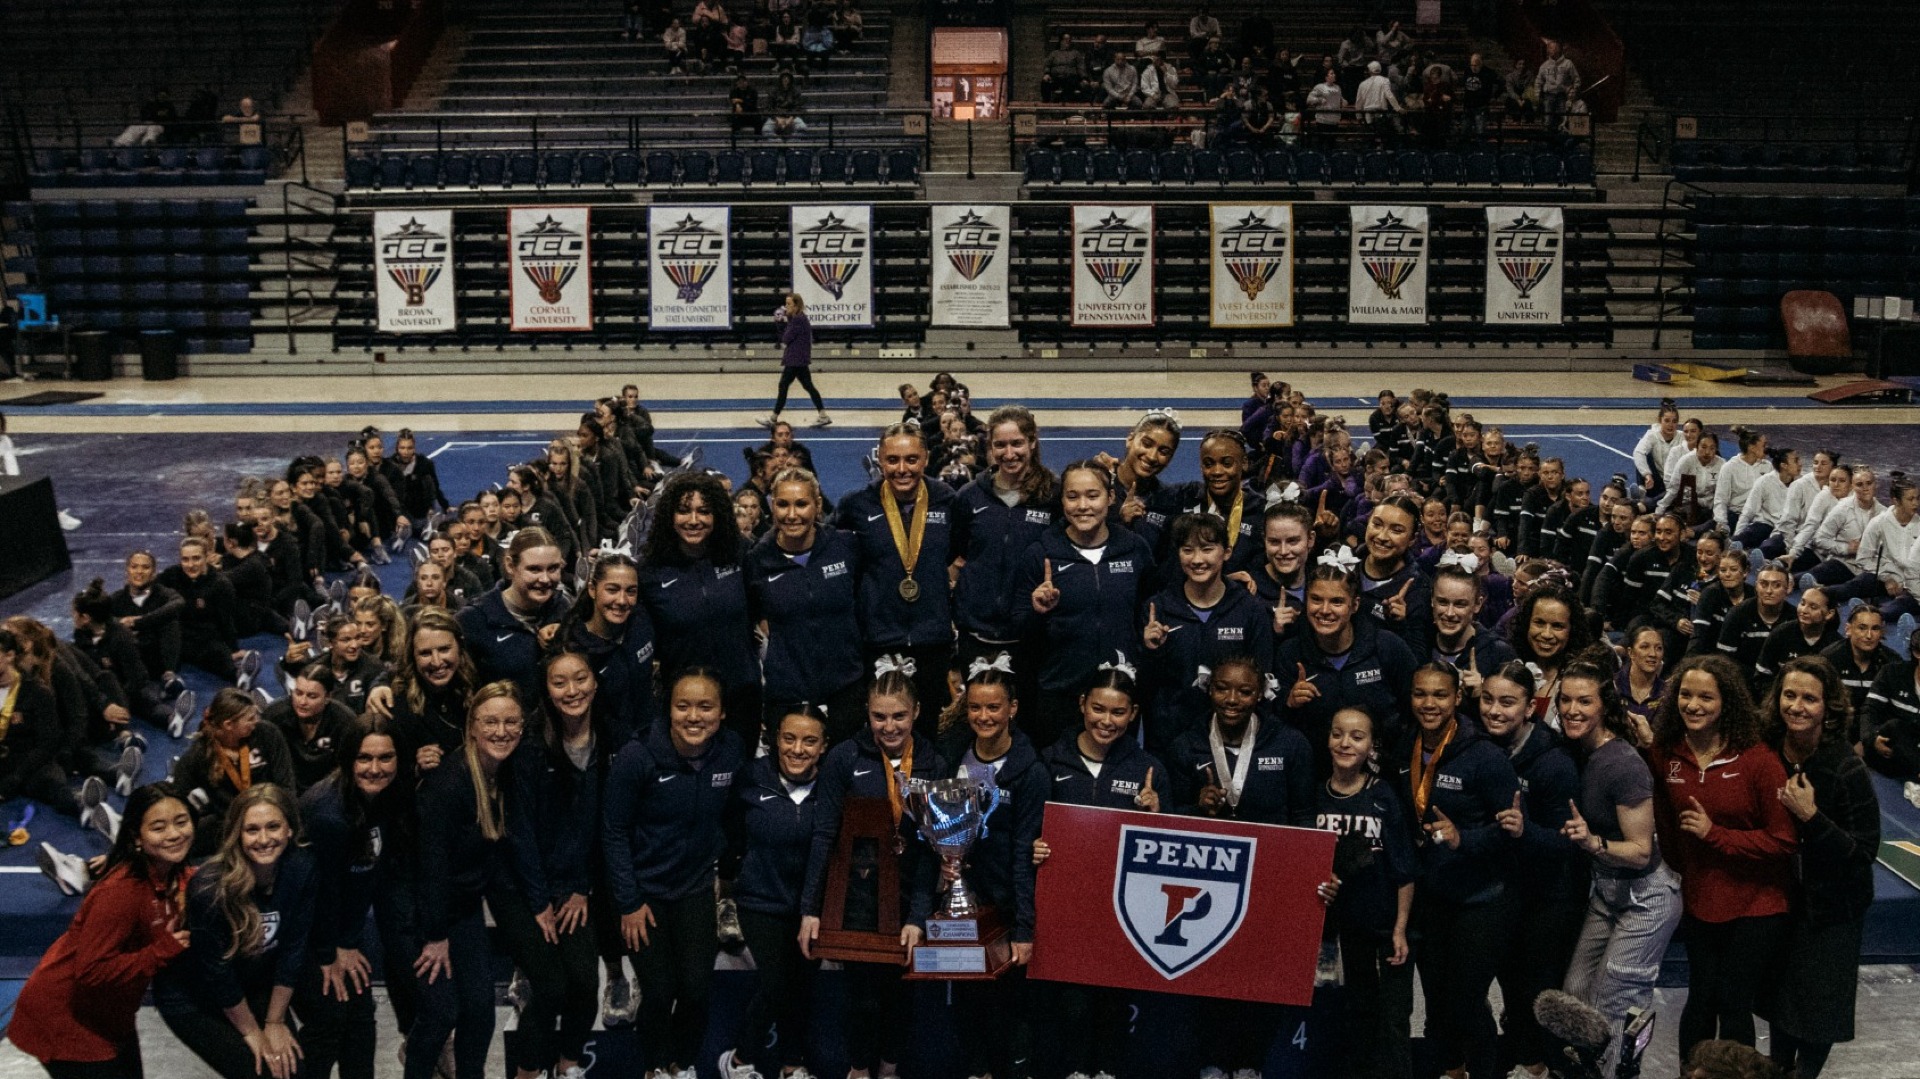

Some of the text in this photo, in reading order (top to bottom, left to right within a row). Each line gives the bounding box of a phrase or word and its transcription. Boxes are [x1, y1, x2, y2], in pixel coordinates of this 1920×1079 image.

[943, 228, 1000, 246] GEC
[1081, 232, 1149, 252] GEC
[1220, 232, 1287, 252] GEC
[1358, 232, 1425, 252] GEC
[1494, 232, 1561, 252] GEC
[383, 238, 448, 258] GEC
[518, 236, 584, 256] GEC
[658, 234, 724, 254] GEC
[799, 233, 867, 253] GEC
[406, 284, 425, 306] B
[530, 306, 571, 315] CORNELL
[653, 305, 727, 314] SOUTHERN CONNECTICUT
[805, 303, 866, 311] NIVERSITY OF
[1078, 303, 1147, 311] UNIVERSITY OF
[1218, 303, 1285, 311] WEST CHESTER
[1351, 306, 1425, 315] WILLIAM & MARY
[1513, 302, 1534, 310] YALE
[397, 308, 433, 316] BROWN
[808, 313, 861, 321] RIDGEPORT
[1078, 312, 1147, 321] PENNSYLVANIA
[1225, 312, 1278, 321] UNIVERSITY
[1497, 311, 1550, 320] UNIVERSITY
[390, 317, 442, 326] UNIVERSITY
[524, 316, 577, 324] UNIVERSITY
[665, 315, 714, 323] STATE UNIVERSITY
[822, 561, 846, 574] PENN
[1108, 560, 1132, 568] PENN
[1355, 669, 1381, 681] PENN
[350, 680, 363, 693] C
[1258, 757, 1284, 765] PENN
[1438, 774, 1463, 784] PENN
[1112, 780, 1140, 790] PENN
[1132, 838, 1241, 872] PENN
[1154, 883, 1212, 947] P
[1292, 1020, 1308, 1050] 4
[583, 1040, 597, 1072] 5
